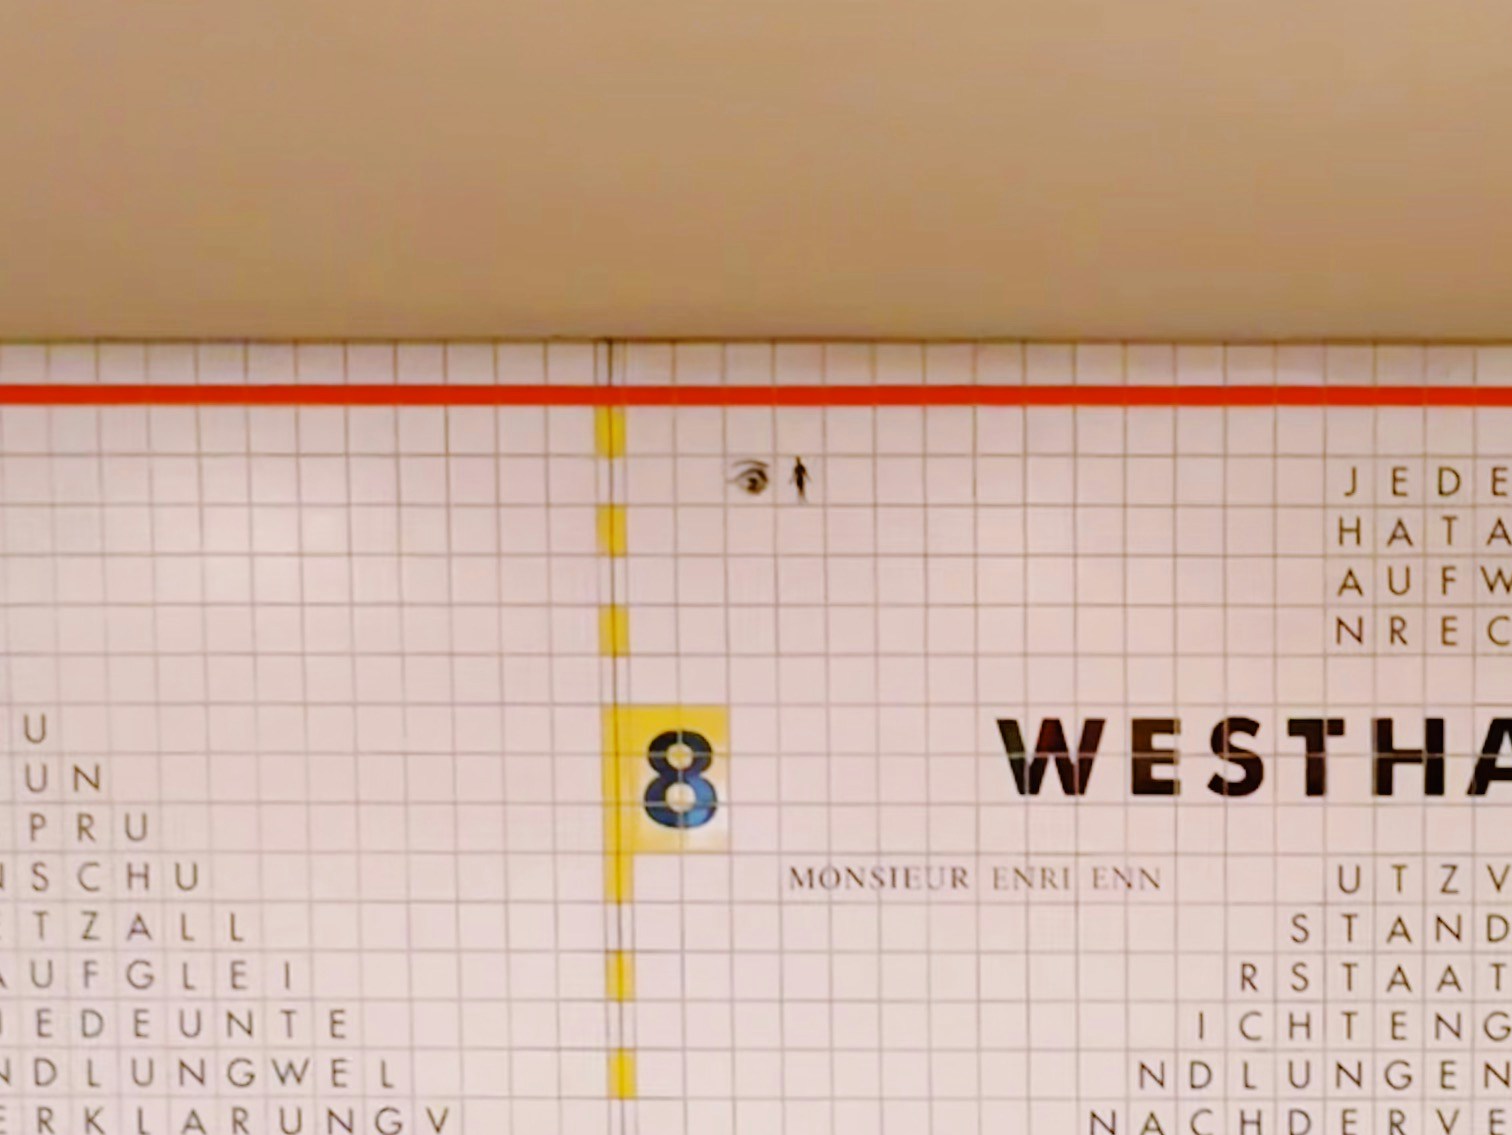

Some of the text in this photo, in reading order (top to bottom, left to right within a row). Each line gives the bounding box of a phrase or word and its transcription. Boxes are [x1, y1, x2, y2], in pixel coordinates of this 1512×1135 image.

[24, 714, 46, 744] U
[25, 763, 101, 793] UN
[643, 729, 719, 829] 8
[30, 813, 147, 842] PRU
[0, 862, 198, 892] SCHU
[790, 866, 1161, 890] MONSIEUR ENRI ENN
[0, 960, 290, 990] UFGLEI
